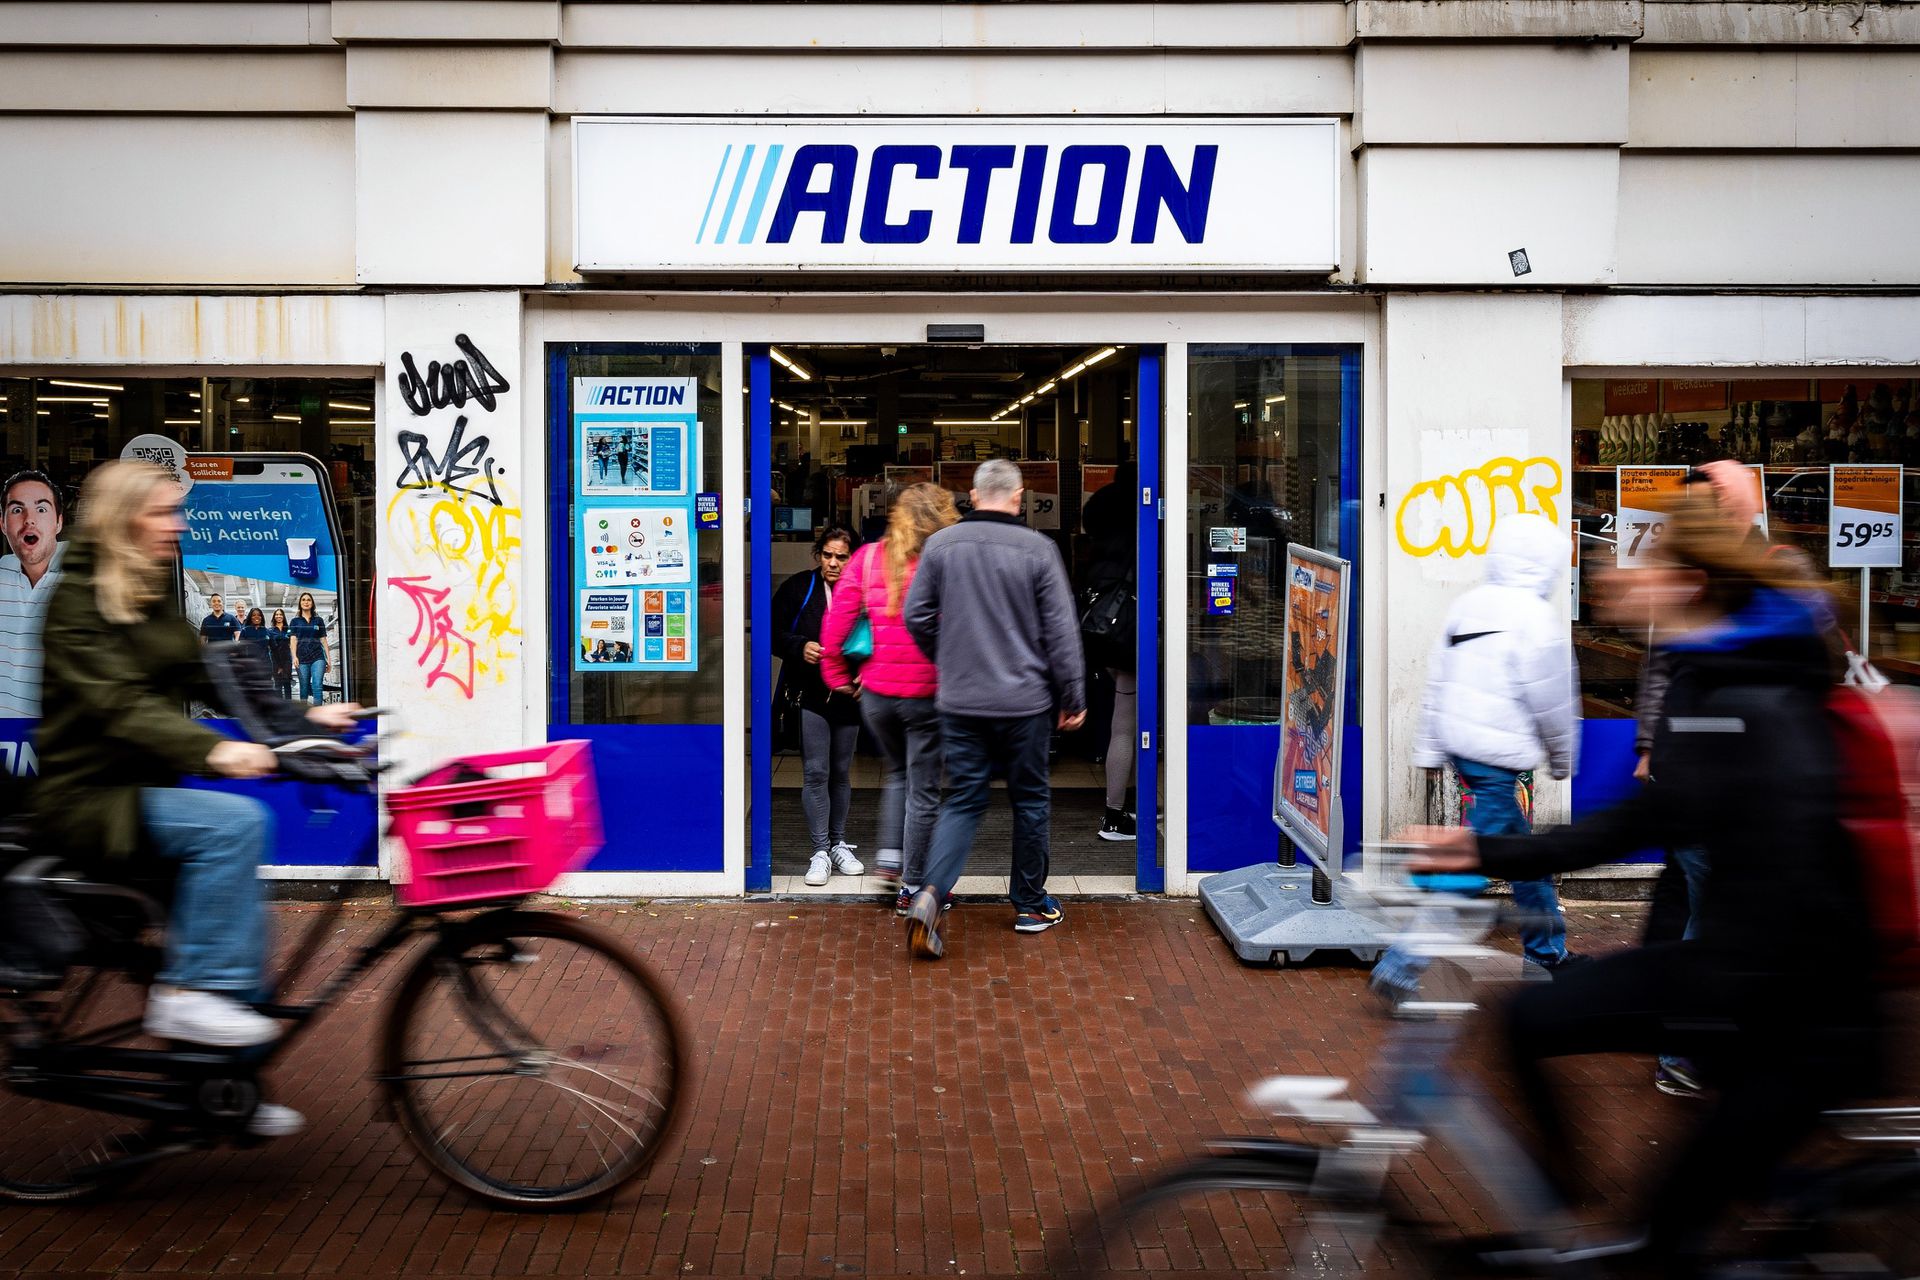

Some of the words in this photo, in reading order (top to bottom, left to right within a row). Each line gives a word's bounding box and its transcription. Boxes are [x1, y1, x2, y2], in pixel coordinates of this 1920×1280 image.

[766, 144, 1219, 245] ACTION
[600, 385, 685, 406] ACTION
[1834, 475, 1897, 483] hogedrukreiniger
[184, 507, 223, 521] Kom
[228, 507, 293, 521] werken
[189, 527, 212, 544] bij
[218, 528, 280, 541] Action!
[1295, 774, 1317, 791] EXTREEM
